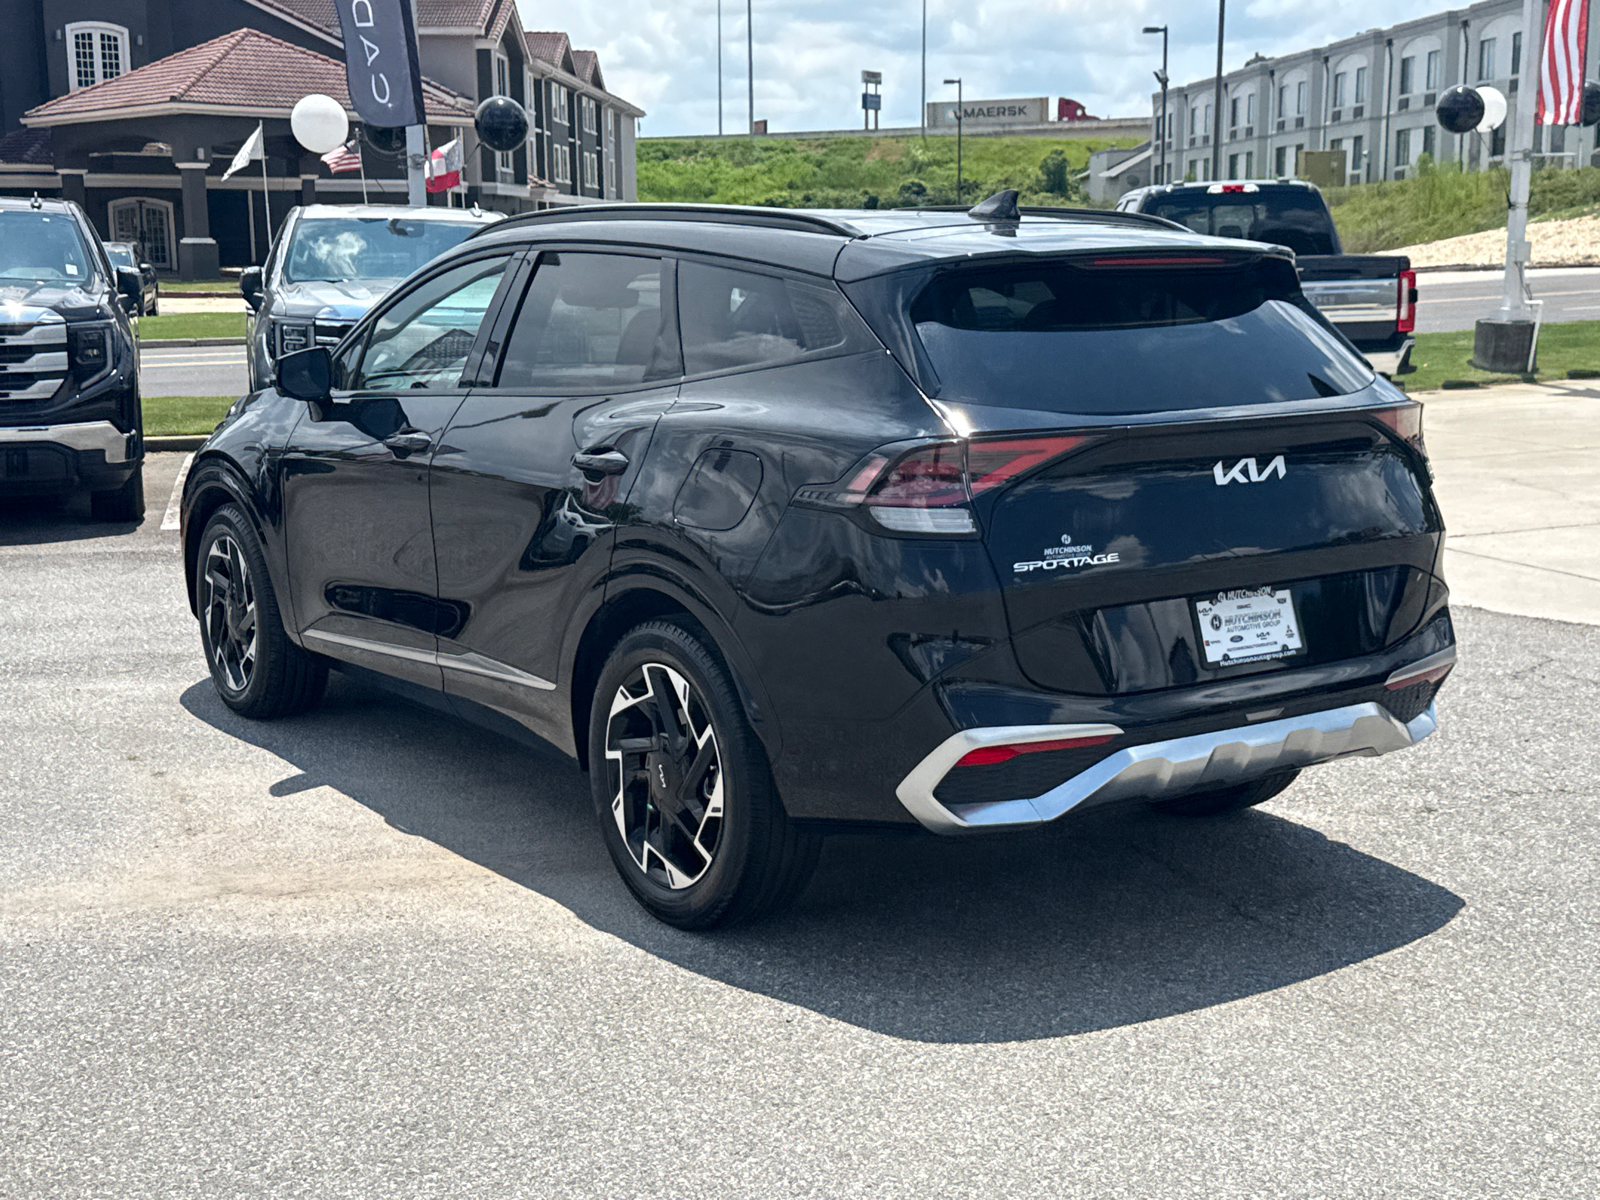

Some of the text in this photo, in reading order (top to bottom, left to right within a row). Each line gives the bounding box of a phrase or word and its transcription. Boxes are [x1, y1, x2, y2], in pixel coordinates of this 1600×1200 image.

[963, 105, 1027, 118] MAERSK
[1213, 455, 1286, 485] KIA
[1044, 545, 1092, 556] HUTCHINSON
[1013, 553, 1119, 572] SPORTAGE
[1224, 609, 1281, 626] HUTCHINSON
[1227, 620, 1281, 633] AUTOMOTIVE GROUP
